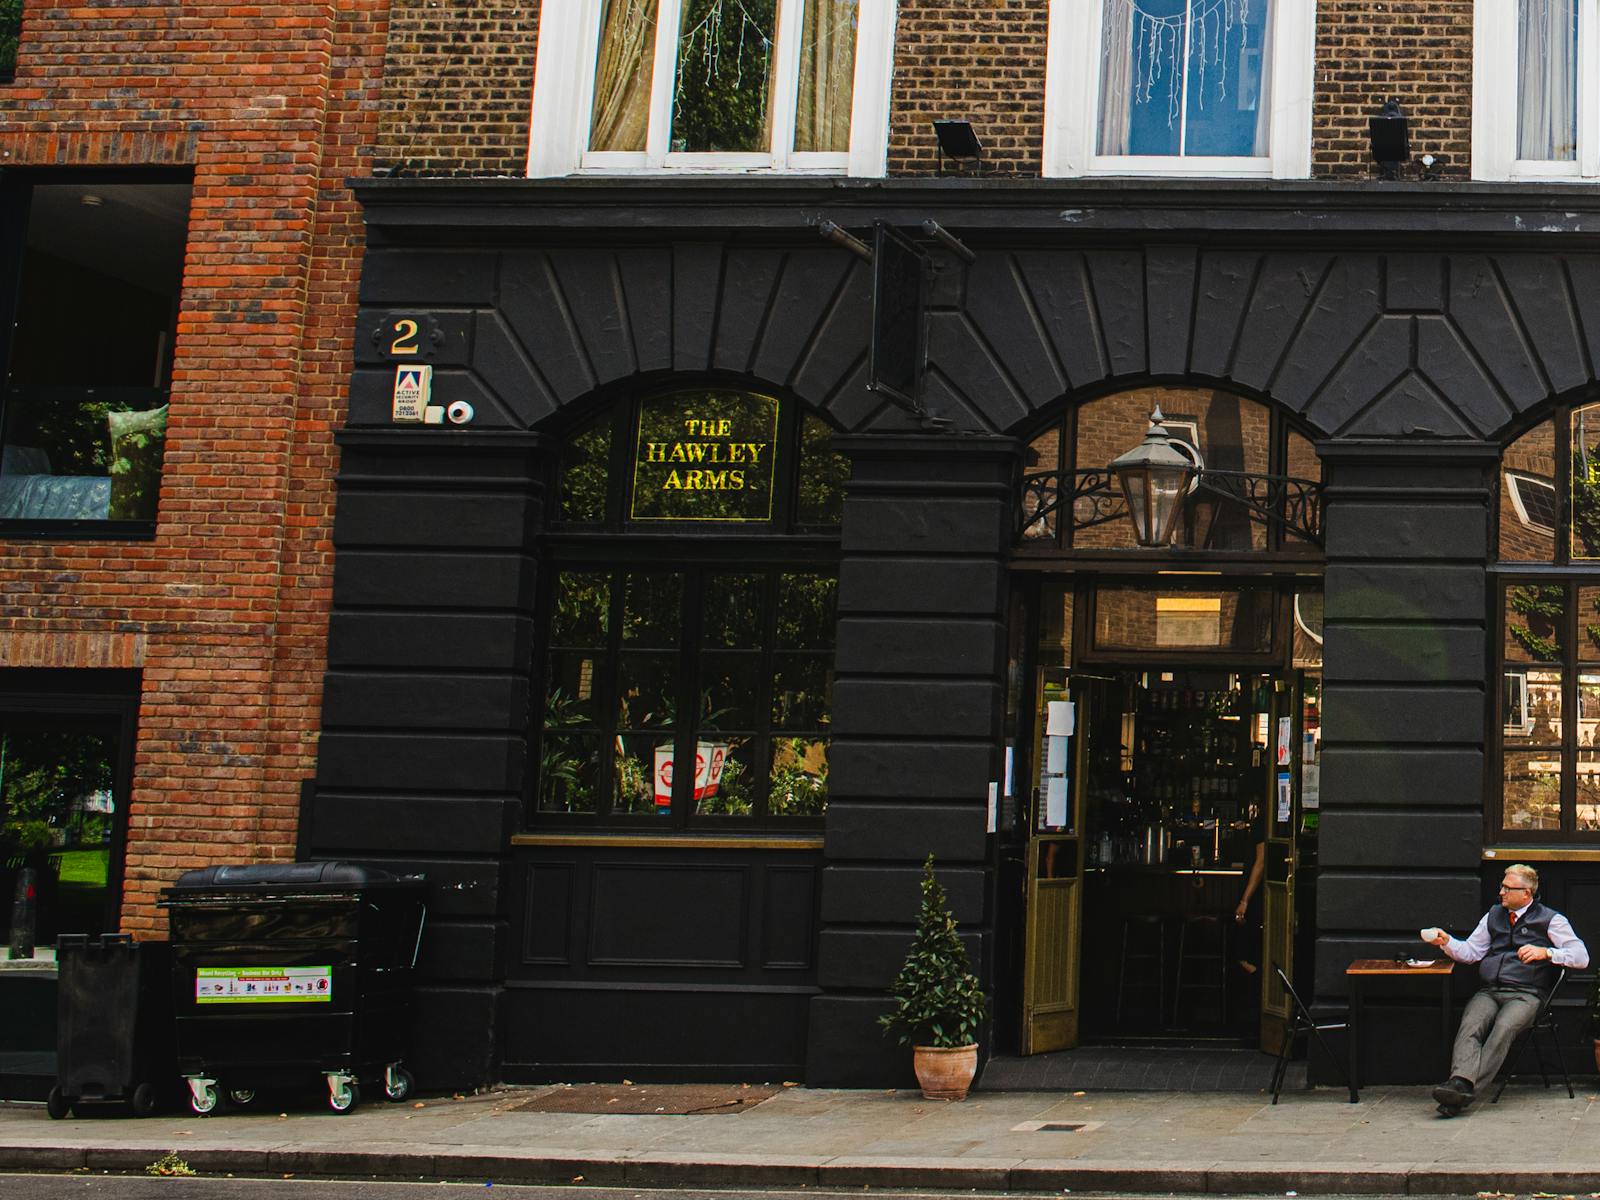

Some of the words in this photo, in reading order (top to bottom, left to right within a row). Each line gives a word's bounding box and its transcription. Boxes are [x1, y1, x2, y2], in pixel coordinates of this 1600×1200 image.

[391, 319, 419, 355] 2
[685, 419, 732, 437] THE
[646, 442, 767, 463] HAWLEY
[663, 469, 745, 490] ARMS
